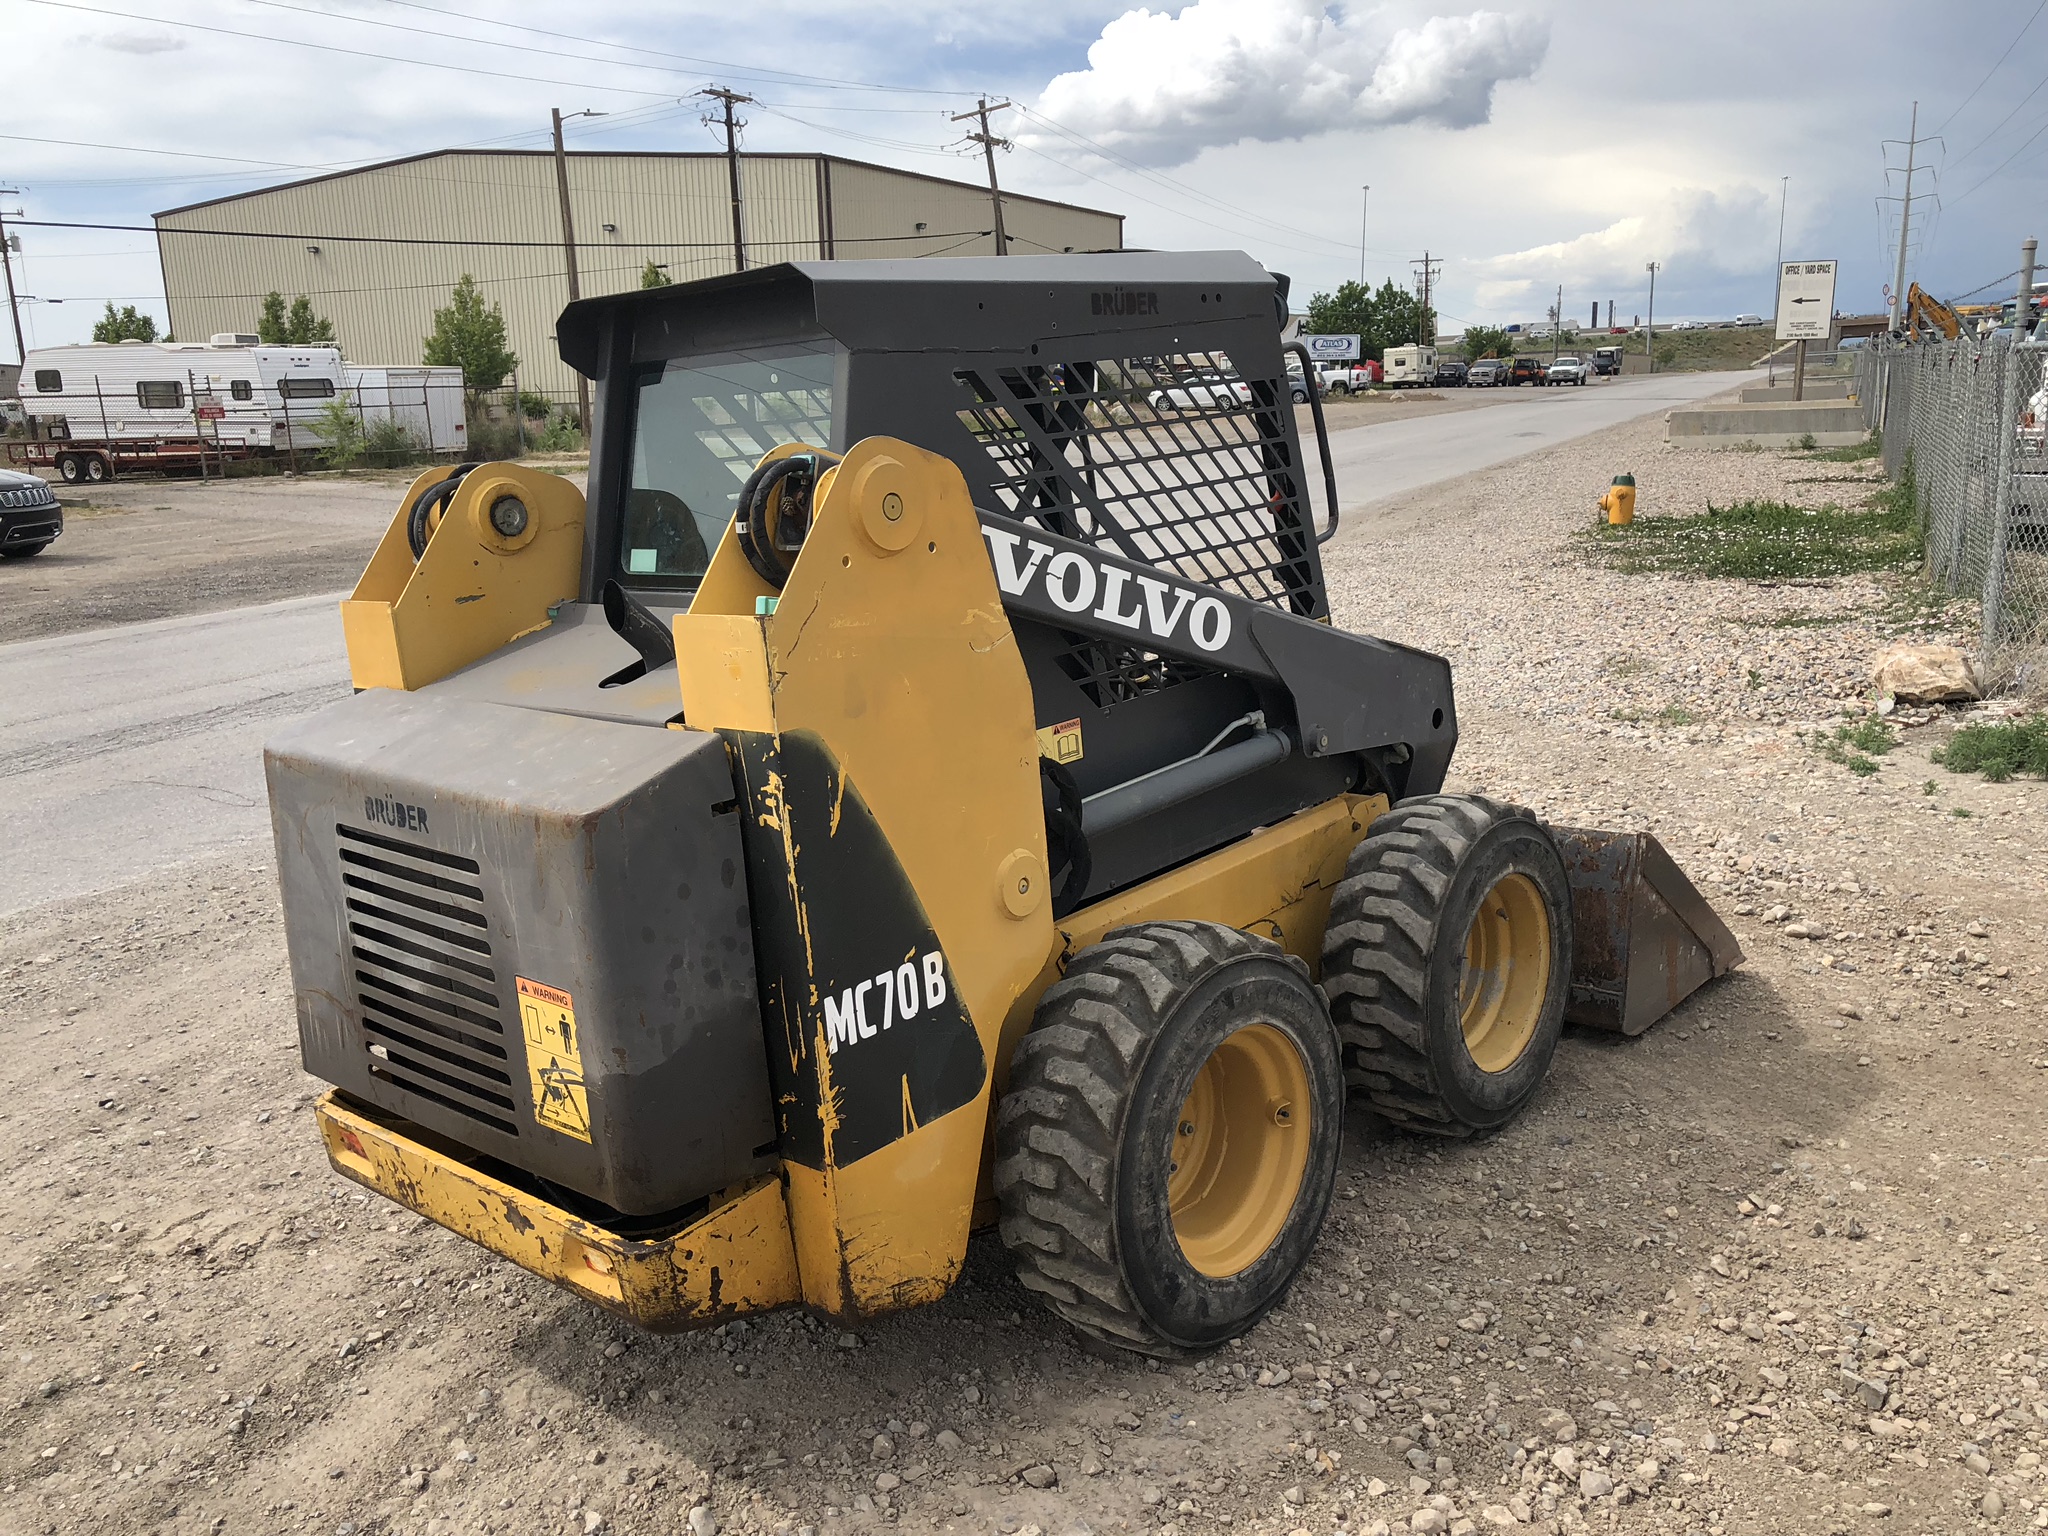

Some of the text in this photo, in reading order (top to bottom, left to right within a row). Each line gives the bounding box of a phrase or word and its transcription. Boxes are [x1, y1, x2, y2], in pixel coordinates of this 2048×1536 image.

[1785, 265, 1800, 275] OFFICE
[1804, 264, 1816, 274] YARD
[1816, 264, 1831, 274] SPACE
[1091, 286, 1159, 316] BRÜDER
[1321, 340, 1344, 348] ATLAS
[980, 525, 1231, 651] VOLVO
[1060, 719, 1080, 731] WARNING
[364, 793, 430, 834] BRÜDER
[532, 985, 569, 1006] WARNING
